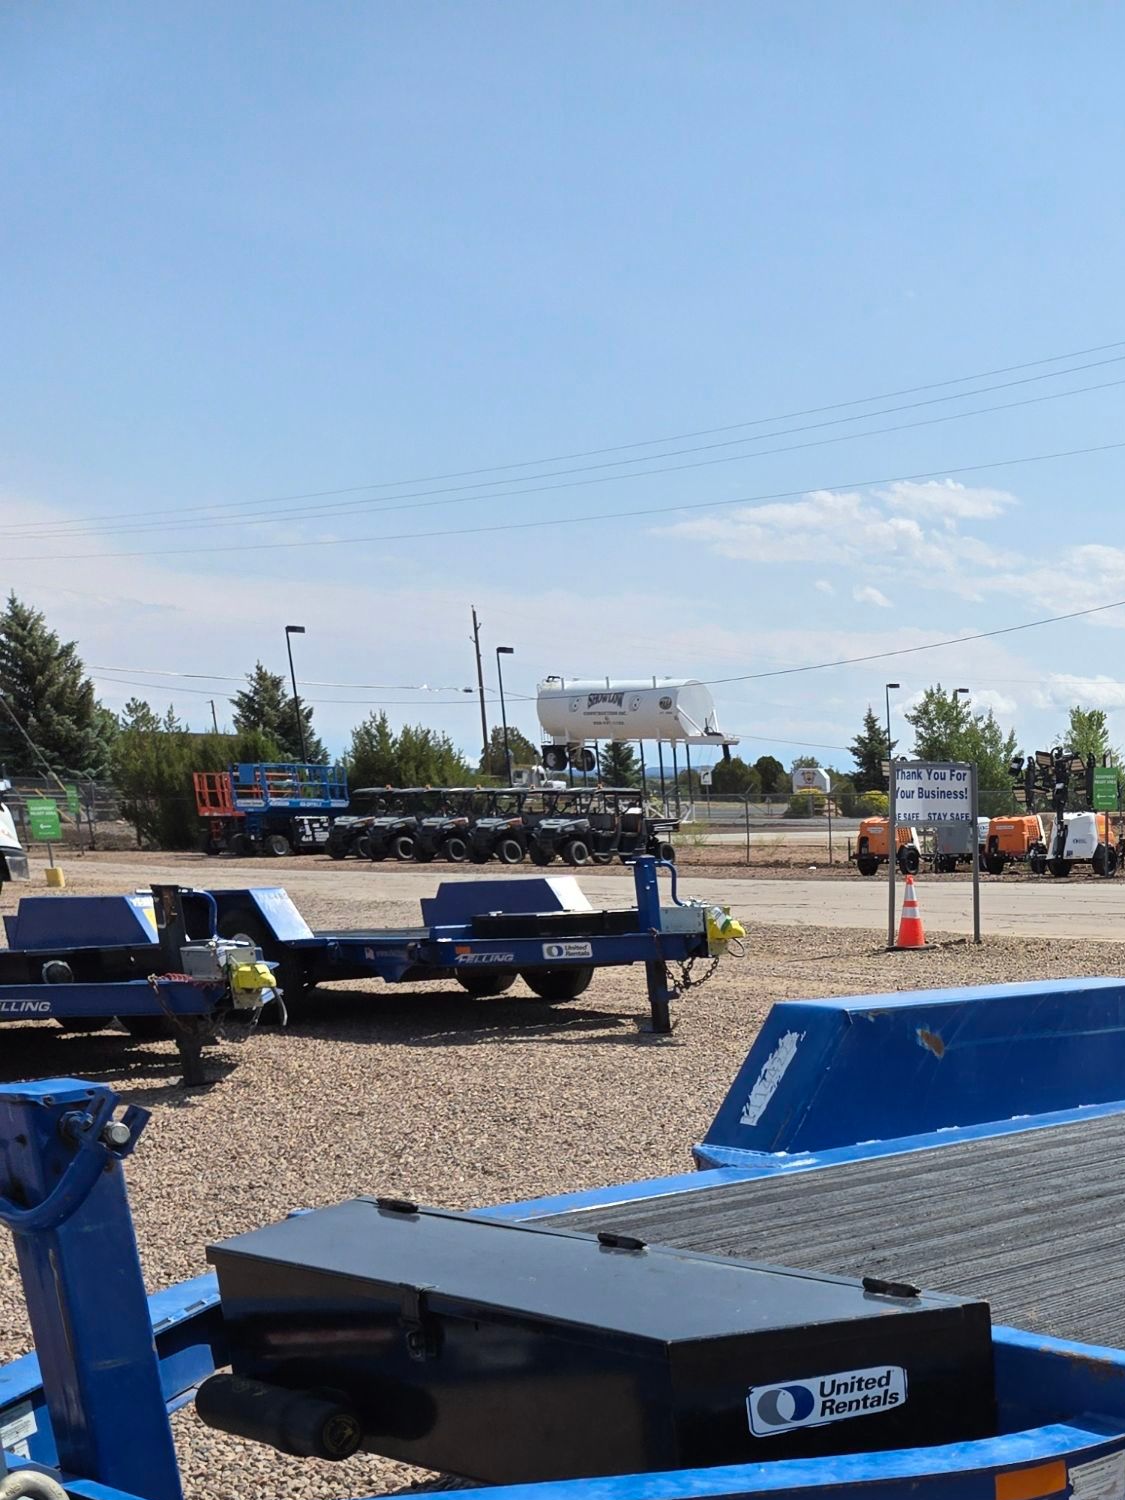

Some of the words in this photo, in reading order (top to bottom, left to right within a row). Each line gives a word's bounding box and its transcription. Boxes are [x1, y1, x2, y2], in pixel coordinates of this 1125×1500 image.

[896, 769, 922, 780] Thank
[926, 769, 946, 781] You
[949, 770, 967, 781] For
[896, 787, 915, 800] Your
[918, 787, 968, 800] Business!
[927, 812, 948, 821] STAY
[0, 1001, 52, 1012] LLING
[819, 1370, 891, 1398] United
[820, 1389, 899, 1417] Rentals
